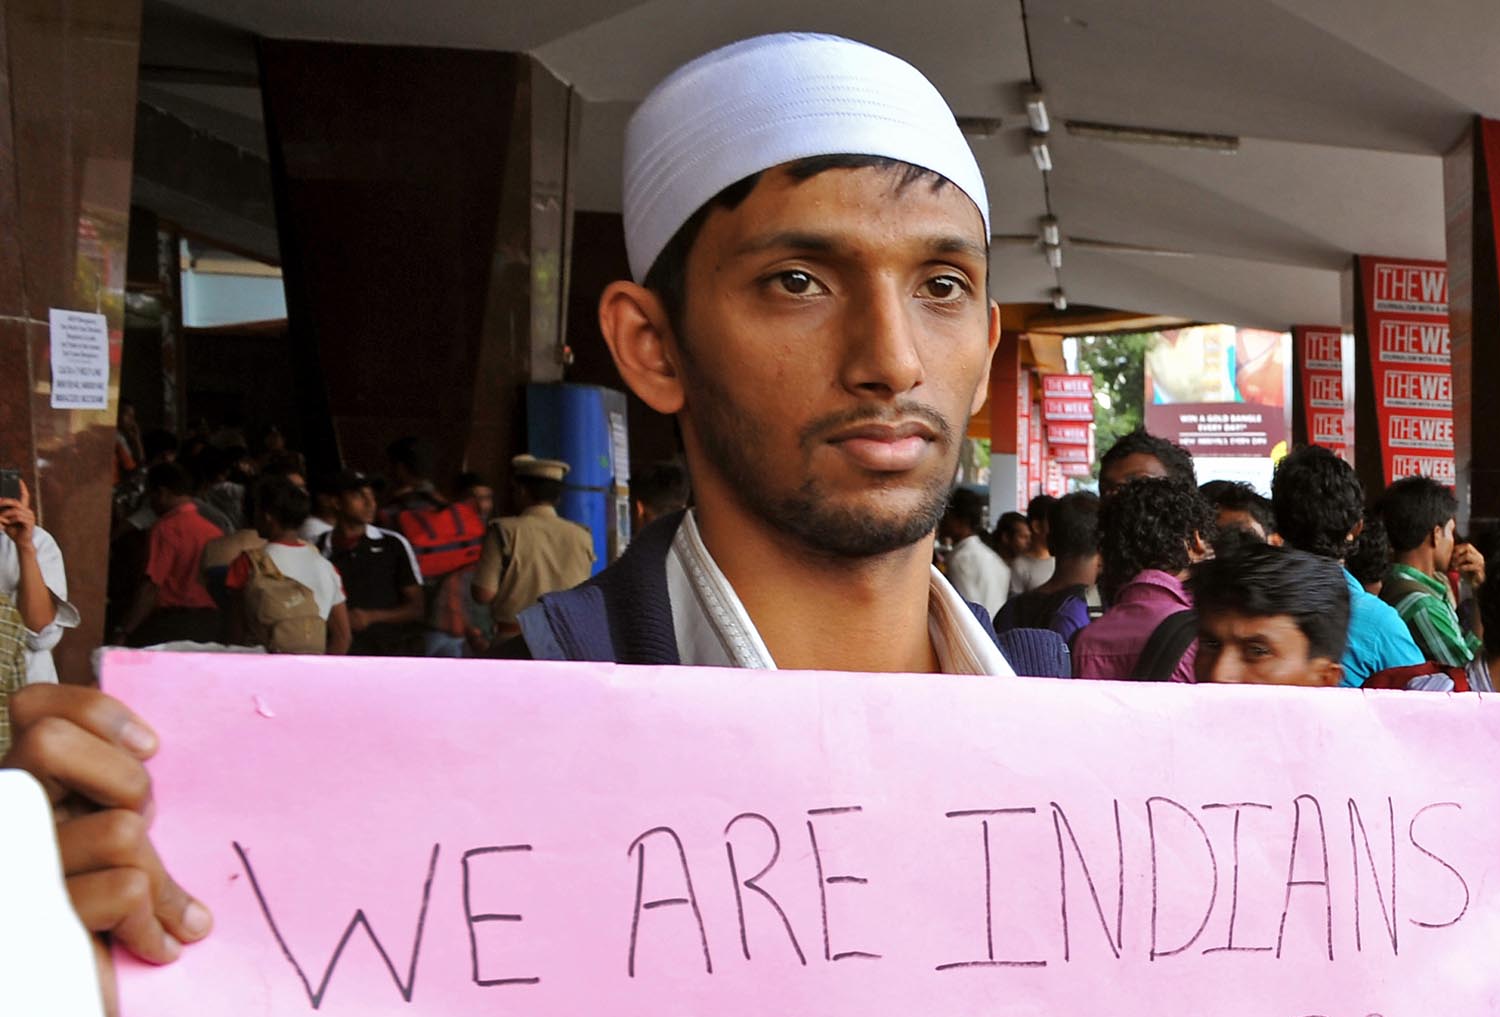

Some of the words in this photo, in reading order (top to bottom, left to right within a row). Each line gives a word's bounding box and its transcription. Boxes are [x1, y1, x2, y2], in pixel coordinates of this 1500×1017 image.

[231, 841, 540, 1010] WE
[627, 806, 882, 978] ARE
[935, 794, 1470, 971] INDIANS
